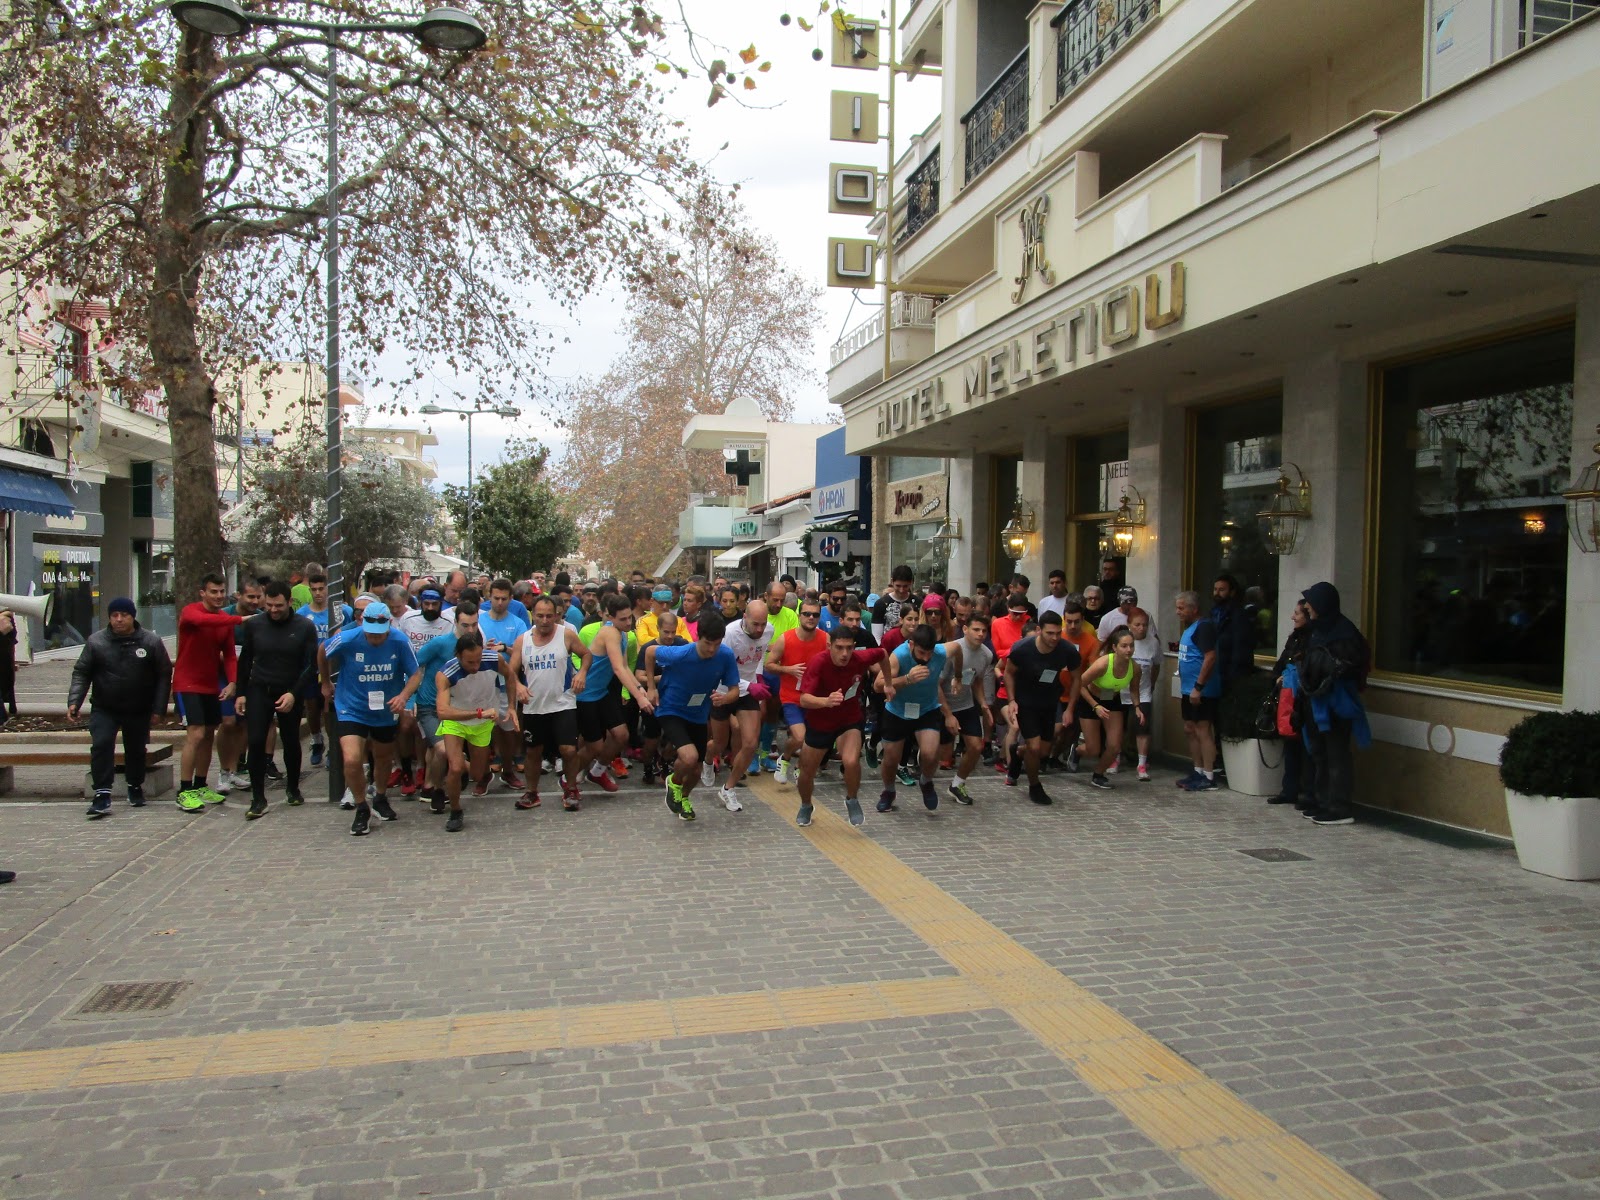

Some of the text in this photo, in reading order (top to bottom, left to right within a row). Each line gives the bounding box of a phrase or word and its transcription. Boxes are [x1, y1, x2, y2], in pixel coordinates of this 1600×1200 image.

[877, 261, 1184, 438] HOTEL MELETIOU
[825, 487, 845, 510] ΗΡΩΝ
[42, 571, 56, 583] ΟΛΑ
[410, 631, 443, 642] DOUB
[529, 653, 555, 662] ΣΔΥΜ
[364, 663, 392, 672] ΣΔΥΜ
[528, 660, 557, 671] ΘΗΒΑΣ
[358, 672, 394, 682] ΘΗΒΑΣ
